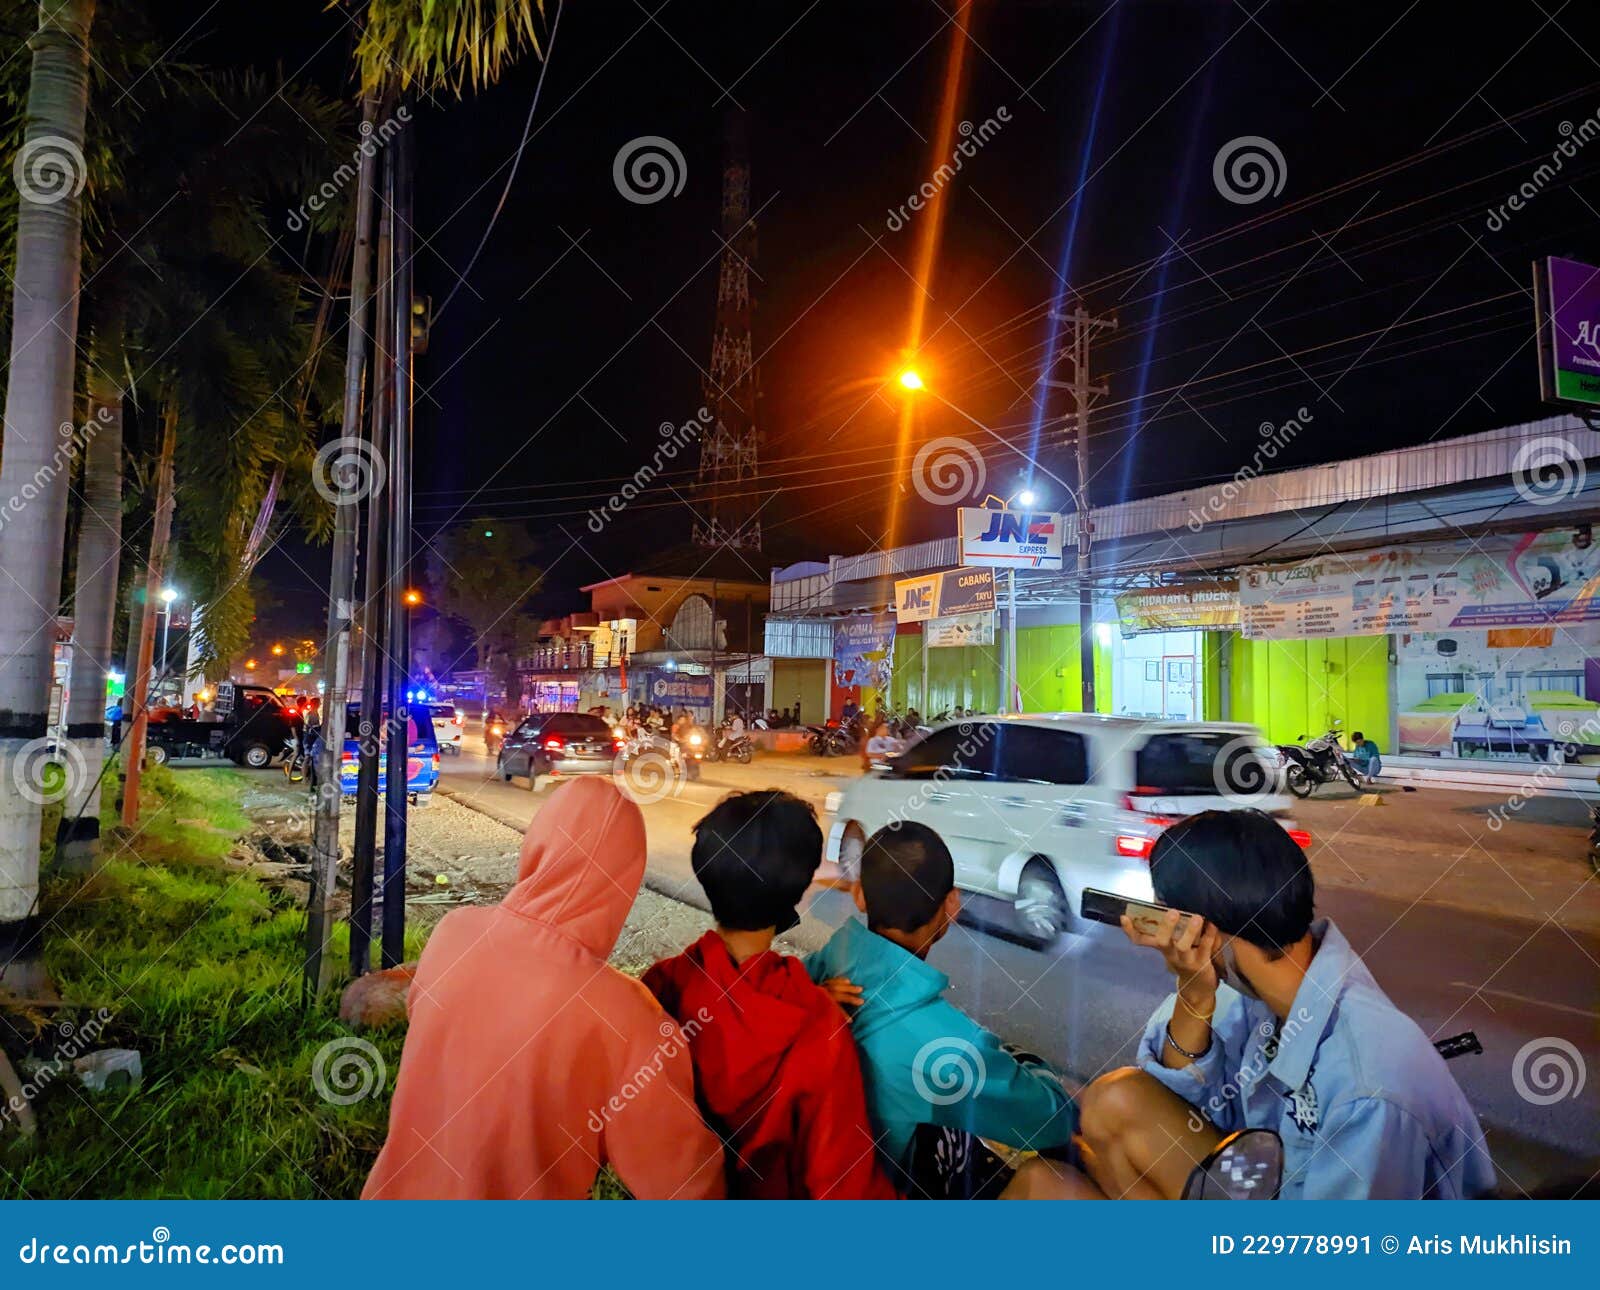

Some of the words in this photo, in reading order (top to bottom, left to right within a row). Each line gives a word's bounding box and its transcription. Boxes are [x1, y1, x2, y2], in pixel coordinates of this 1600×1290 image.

[980, 511, 1055, 545] JNE
[1018, 545, 1048, 555] EXPRESS
[958, 573, 991, 588] CABANG
[902, 585, 933, 610] JNE
[975, 591, 992, 602] TAYU
